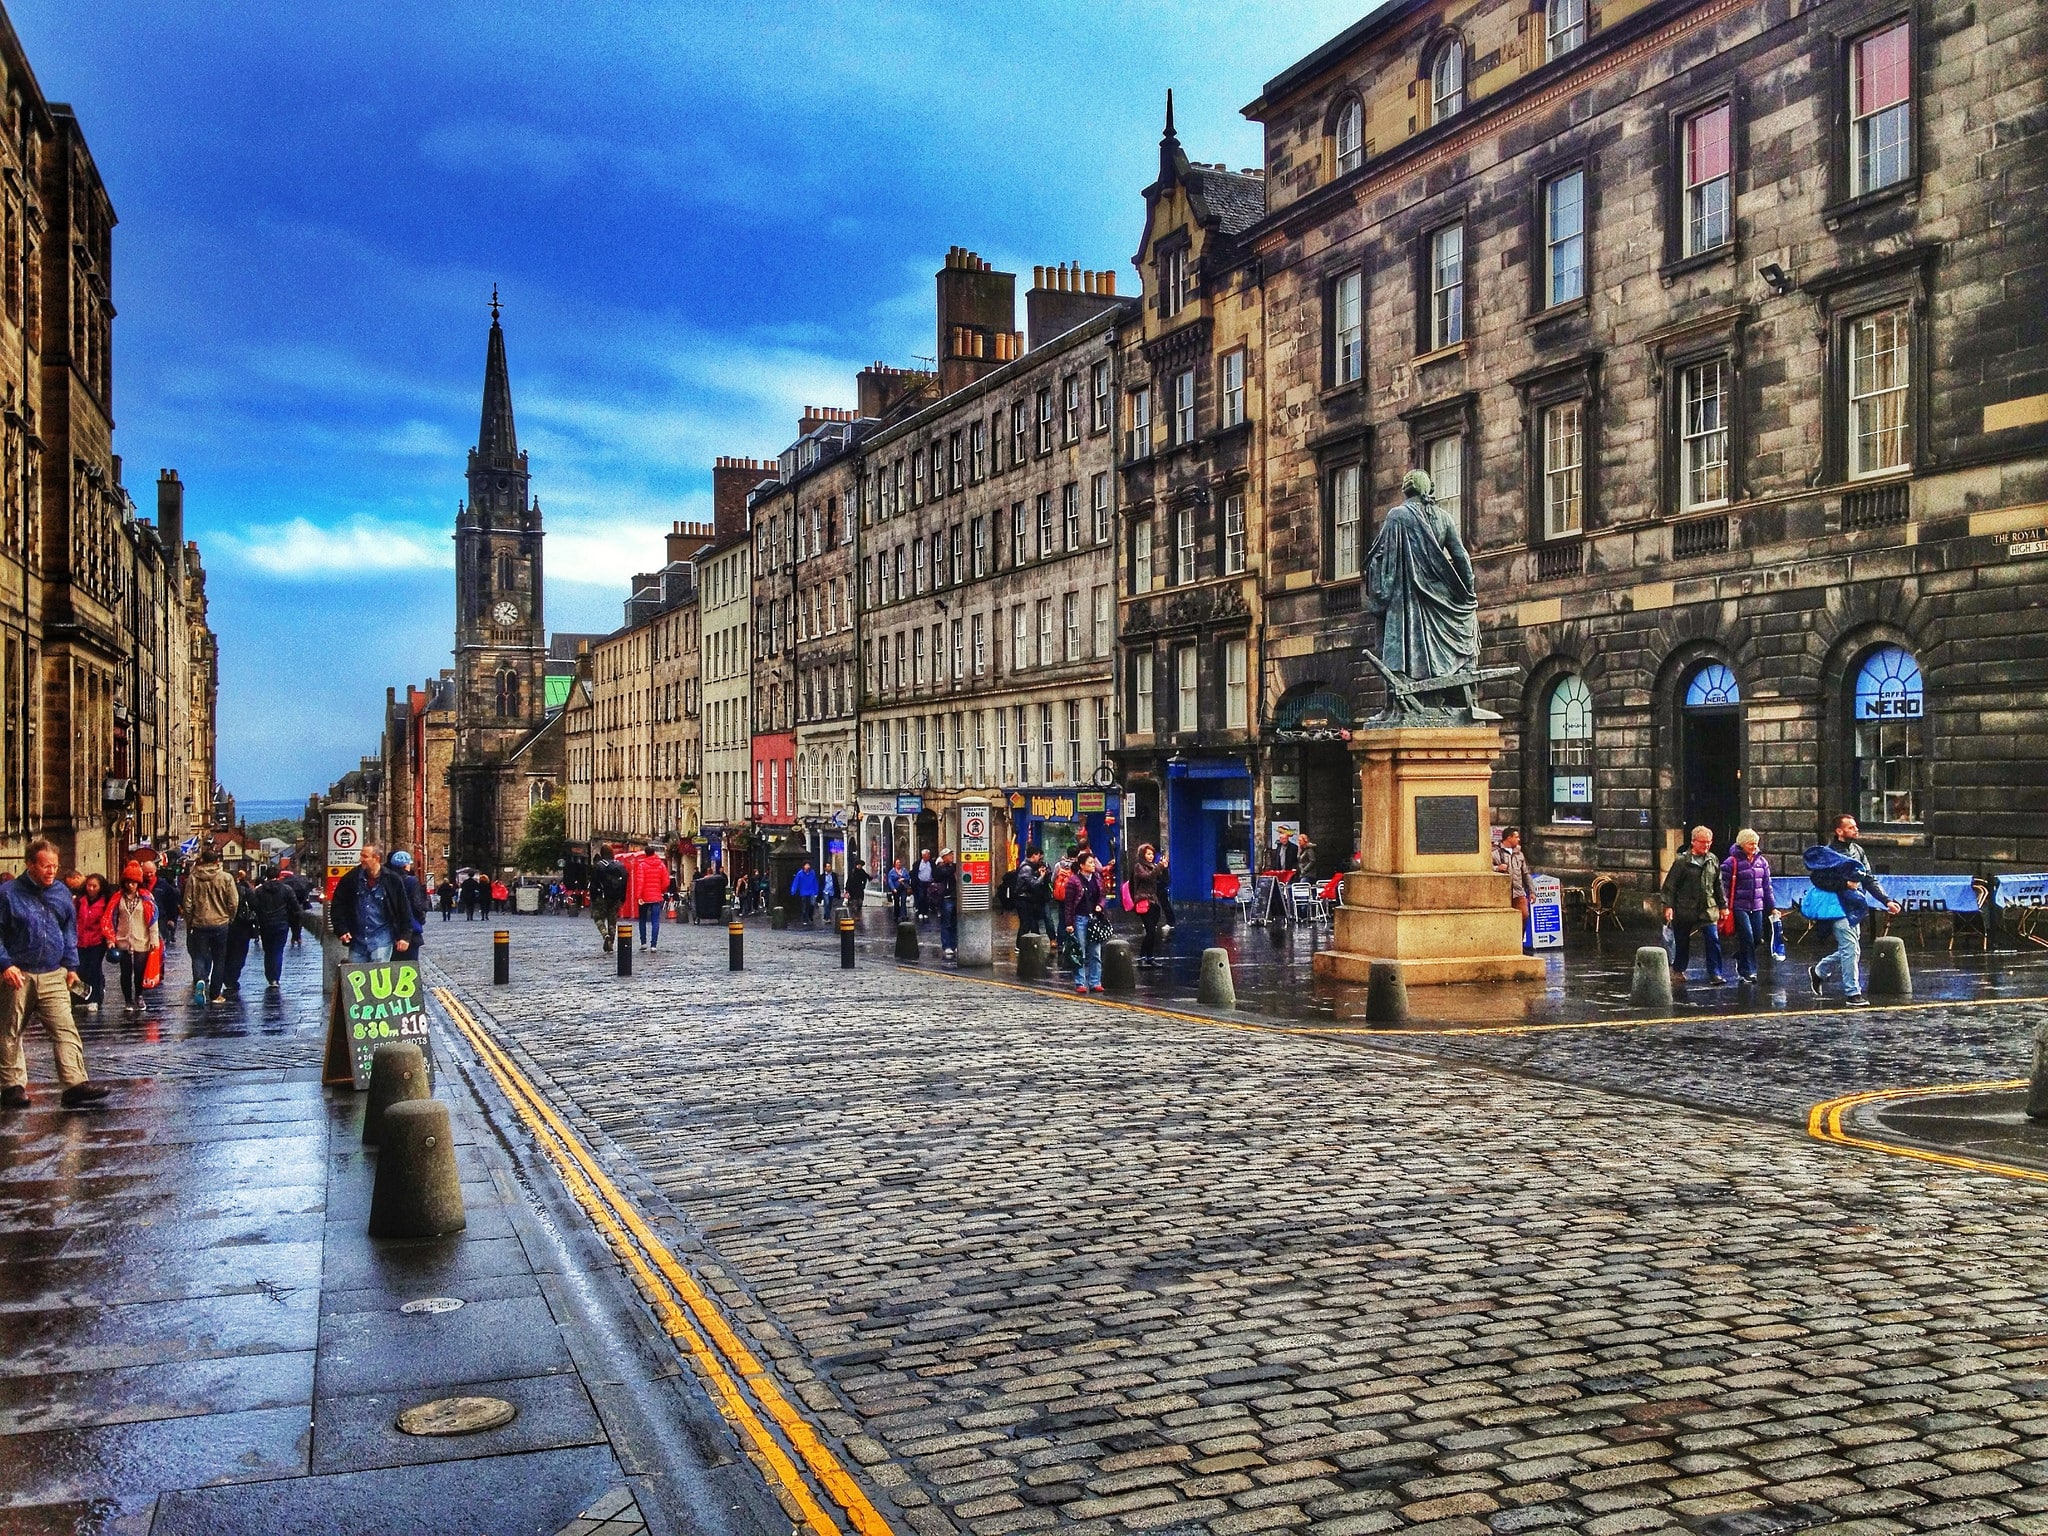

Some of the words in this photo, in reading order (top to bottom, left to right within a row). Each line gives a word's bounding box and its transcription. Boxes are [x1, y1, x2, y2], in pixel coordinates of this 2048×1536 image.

[1993, 534, 2009, 543] THE
[2012, 529, 2039, 541] ROYAL
[2011, 544, 2031, 554] HIGH
[1865, 699, 1920, 715] NERO
[1032, 796, 1054, 819] fringe
[1055, 796, 1073, 820] shop
[347, 966, 418, 1002] PUB
[350, 998, 420, 1019] CRAWL
